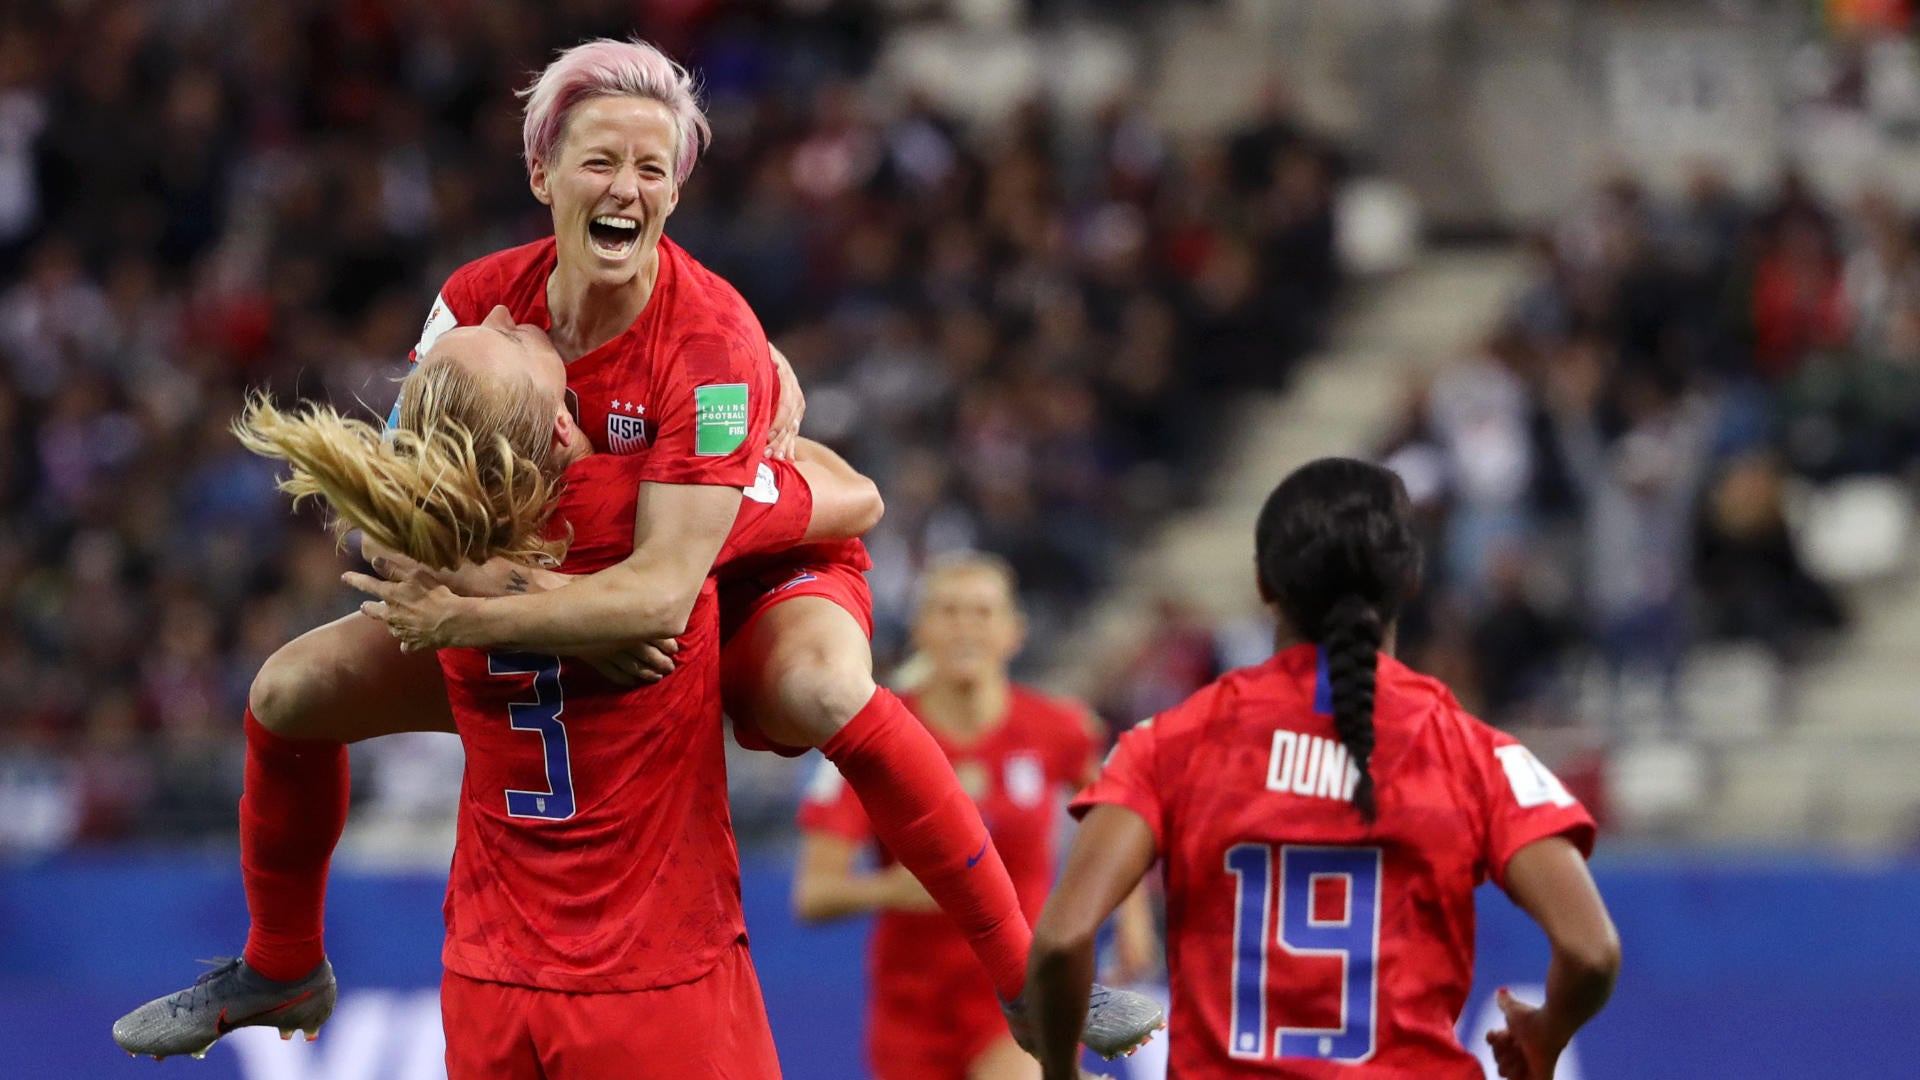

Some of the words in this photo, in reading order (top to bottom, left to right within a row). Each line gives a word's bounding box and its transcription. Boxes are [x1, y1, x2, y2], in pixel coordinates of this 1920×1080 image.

[610, 417, 642, 440] USA
[702, 412, 745, 420] FOOTBALL
[488, 652, 576, 821] 3
[1224, 842, 1382, 1064] 19
